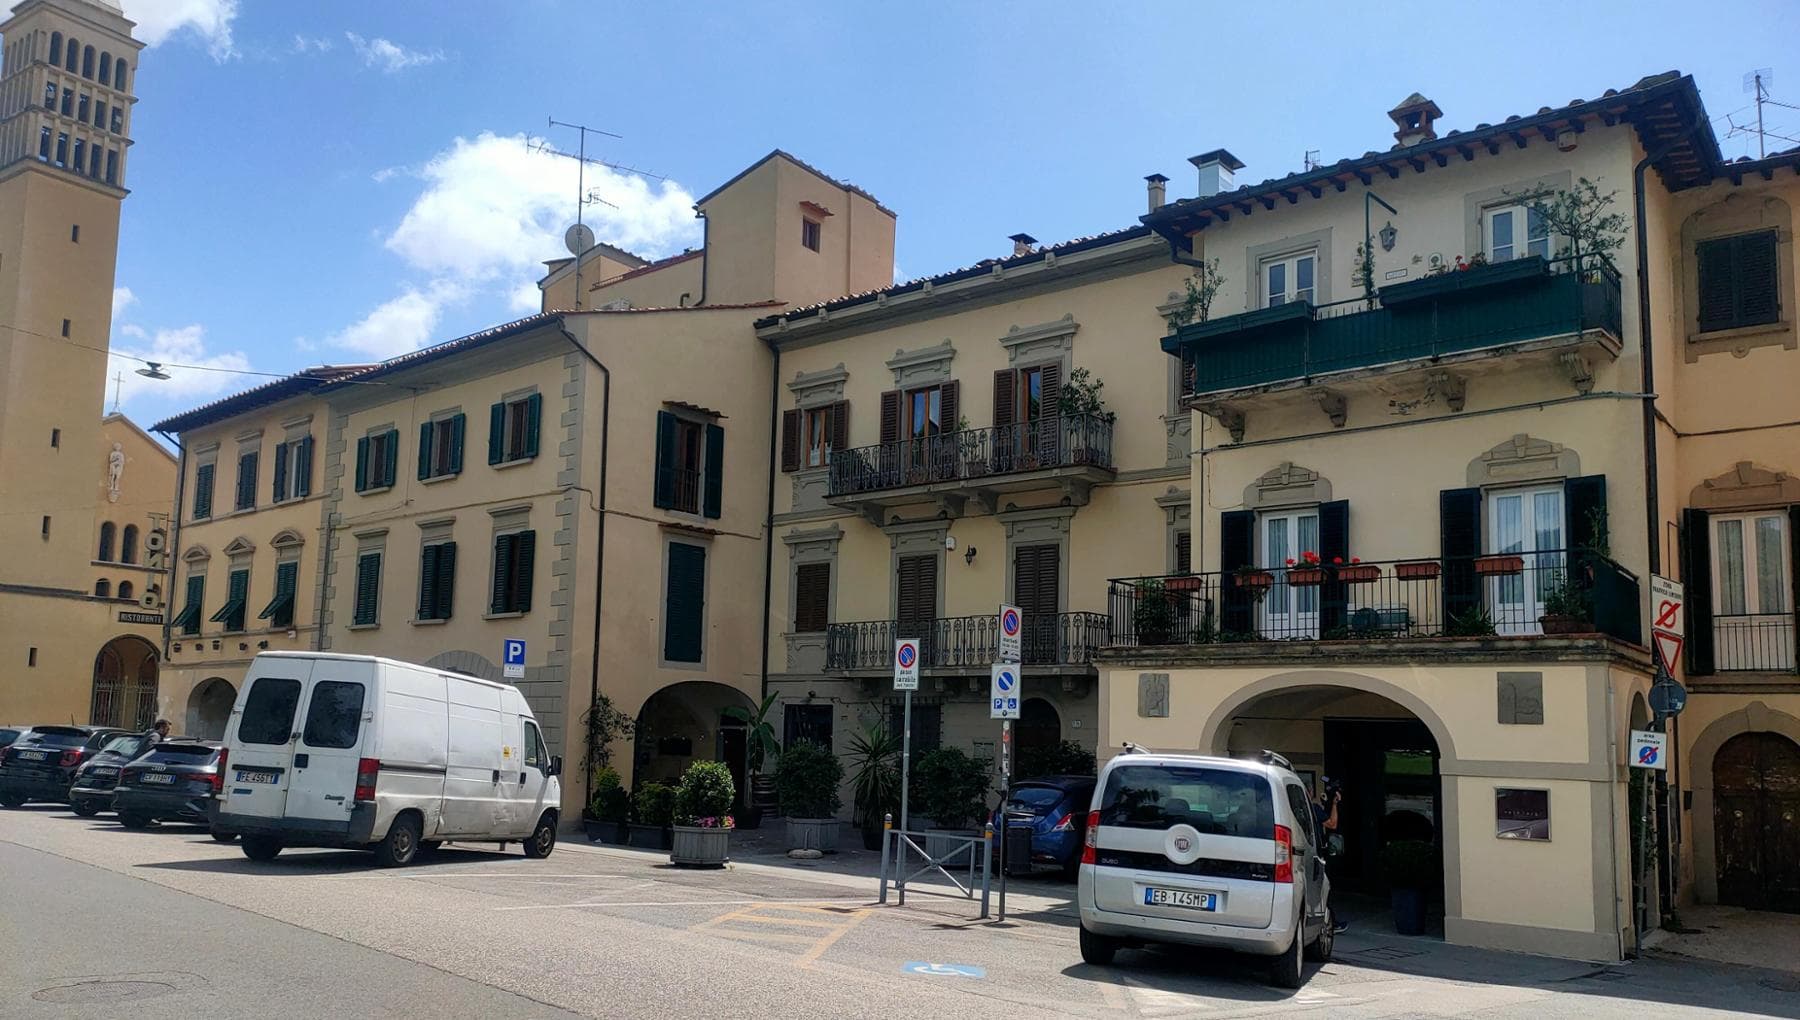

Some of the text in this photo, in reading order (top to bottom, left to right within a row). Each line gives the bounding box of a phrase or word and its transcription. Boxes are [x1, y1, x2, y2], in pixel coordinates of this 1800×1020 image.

[509, 642, 522, 661] P
[1153, 890, 1207, 906] EB 145MP
